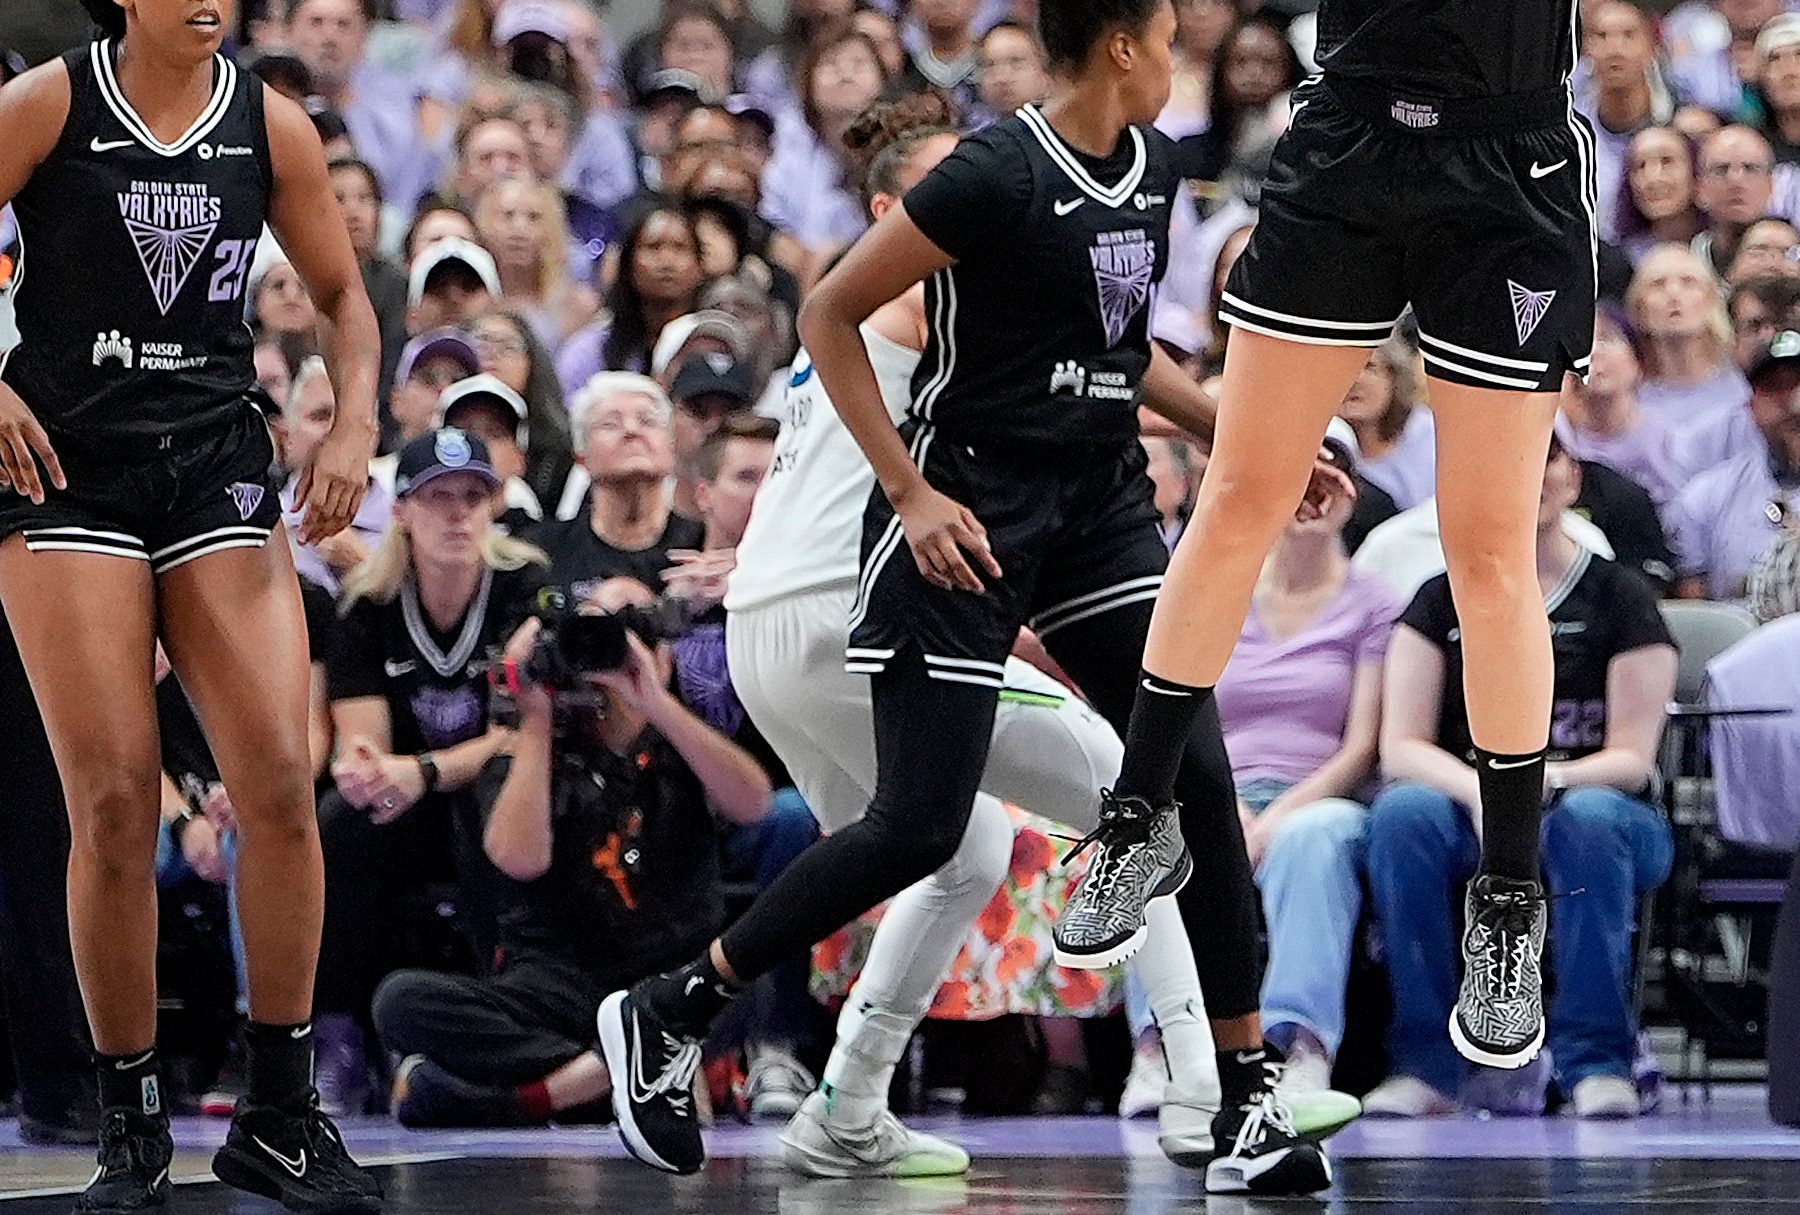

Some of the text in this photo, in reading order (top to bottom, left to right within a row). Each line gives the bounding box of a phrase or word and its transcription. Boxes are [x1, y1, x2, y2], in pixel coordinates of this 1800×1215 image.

[131, 181, 208, 197] GOLDEN STATE
[117, 192, 222, 230] VALKYRIES
[141, 342, 183, 357] KAISER
